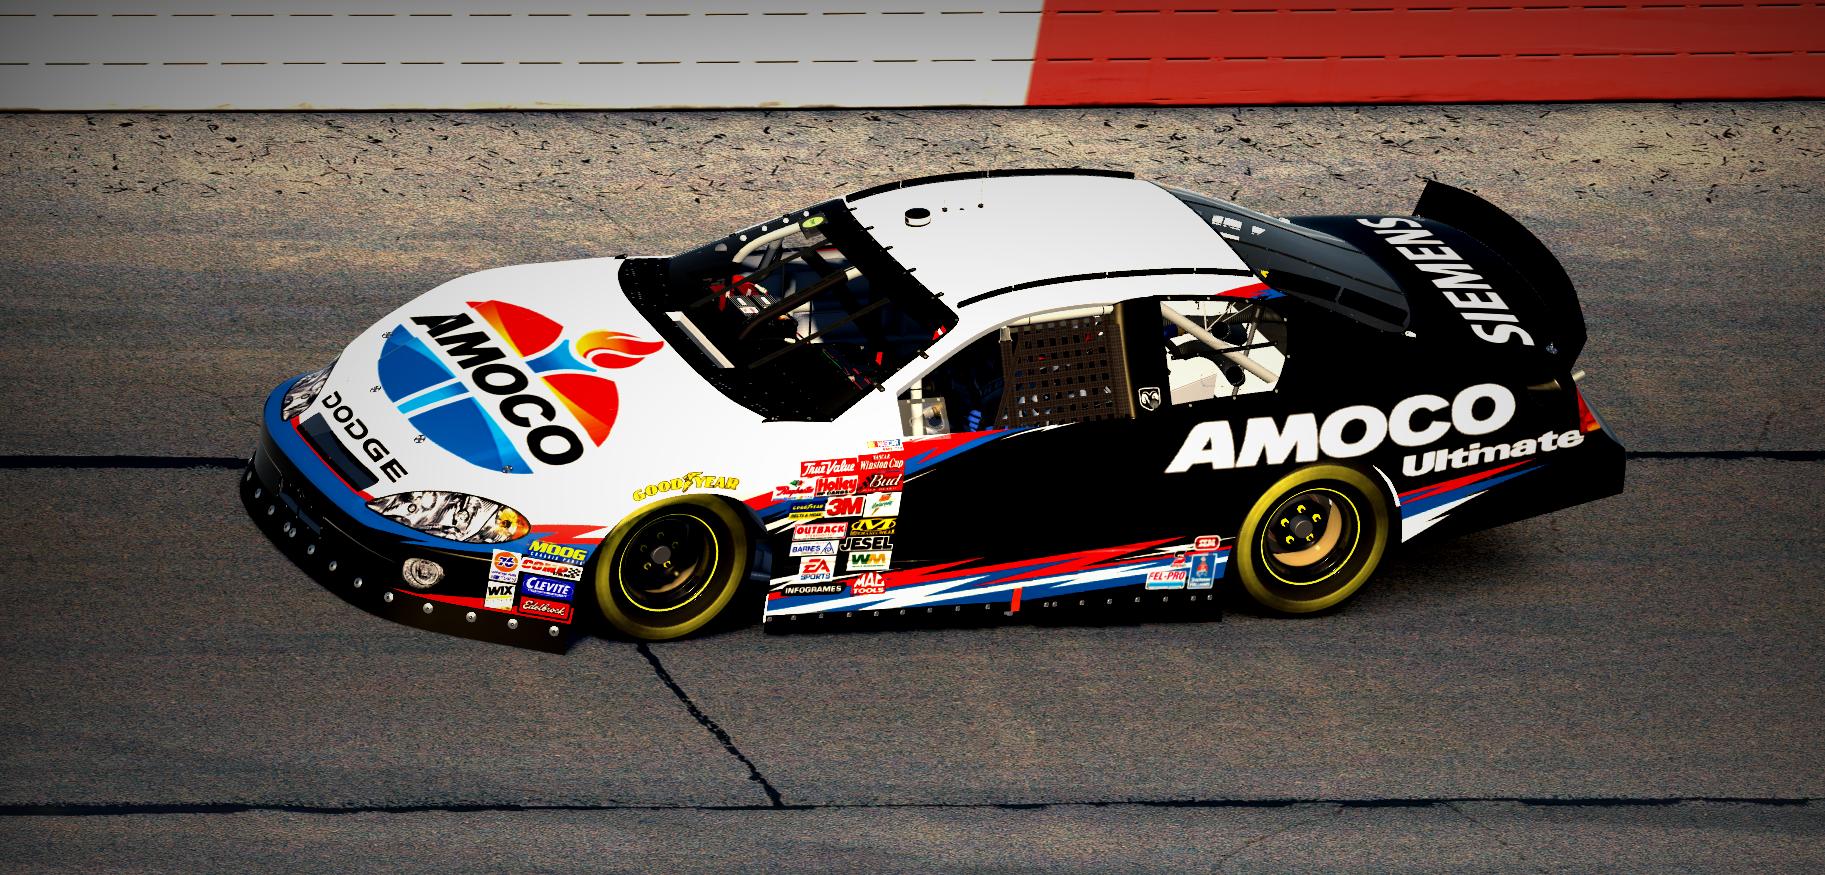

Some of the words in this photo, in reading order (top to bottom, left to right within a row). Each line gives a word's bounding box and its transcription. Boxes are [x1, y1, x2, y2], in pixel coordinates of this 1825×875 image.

[1356, 217, 1535, 346] SIEMENS
[410, 312, 585, 465] AMOCO
[1164, 383, 1516, 473] AMOCO
[322, 390, 408, 483] DODGE
[1402, 429, 1584, 477] Ultimate
[802, 462, 825, 476] True
[821, 460, 855, 474] Value
[860, 460, 888, 470] Winston
[889, 458, 903, 468] Cup
[816, 478, 857, 494] Holley
[870, 474, 902, 488] Bud
[826, 497, 864, 516] 3M
[797, 525, 844, 534] OUTBACK
[529, 540, 588, 561] MOOG
[840, 536, 893, 551] JESEL
[498, 556, 515, 568] 76
[803, 558, 830, 573] EA
[854, 571, 885, 587] MAC
[1149, 571, 1186, 580] FEL-PRO
[488, 586, 513, 595] WIX
[526, 577, 571, 594] CLEVITE
[785, 585, 841, 594] INFOGRAMES
